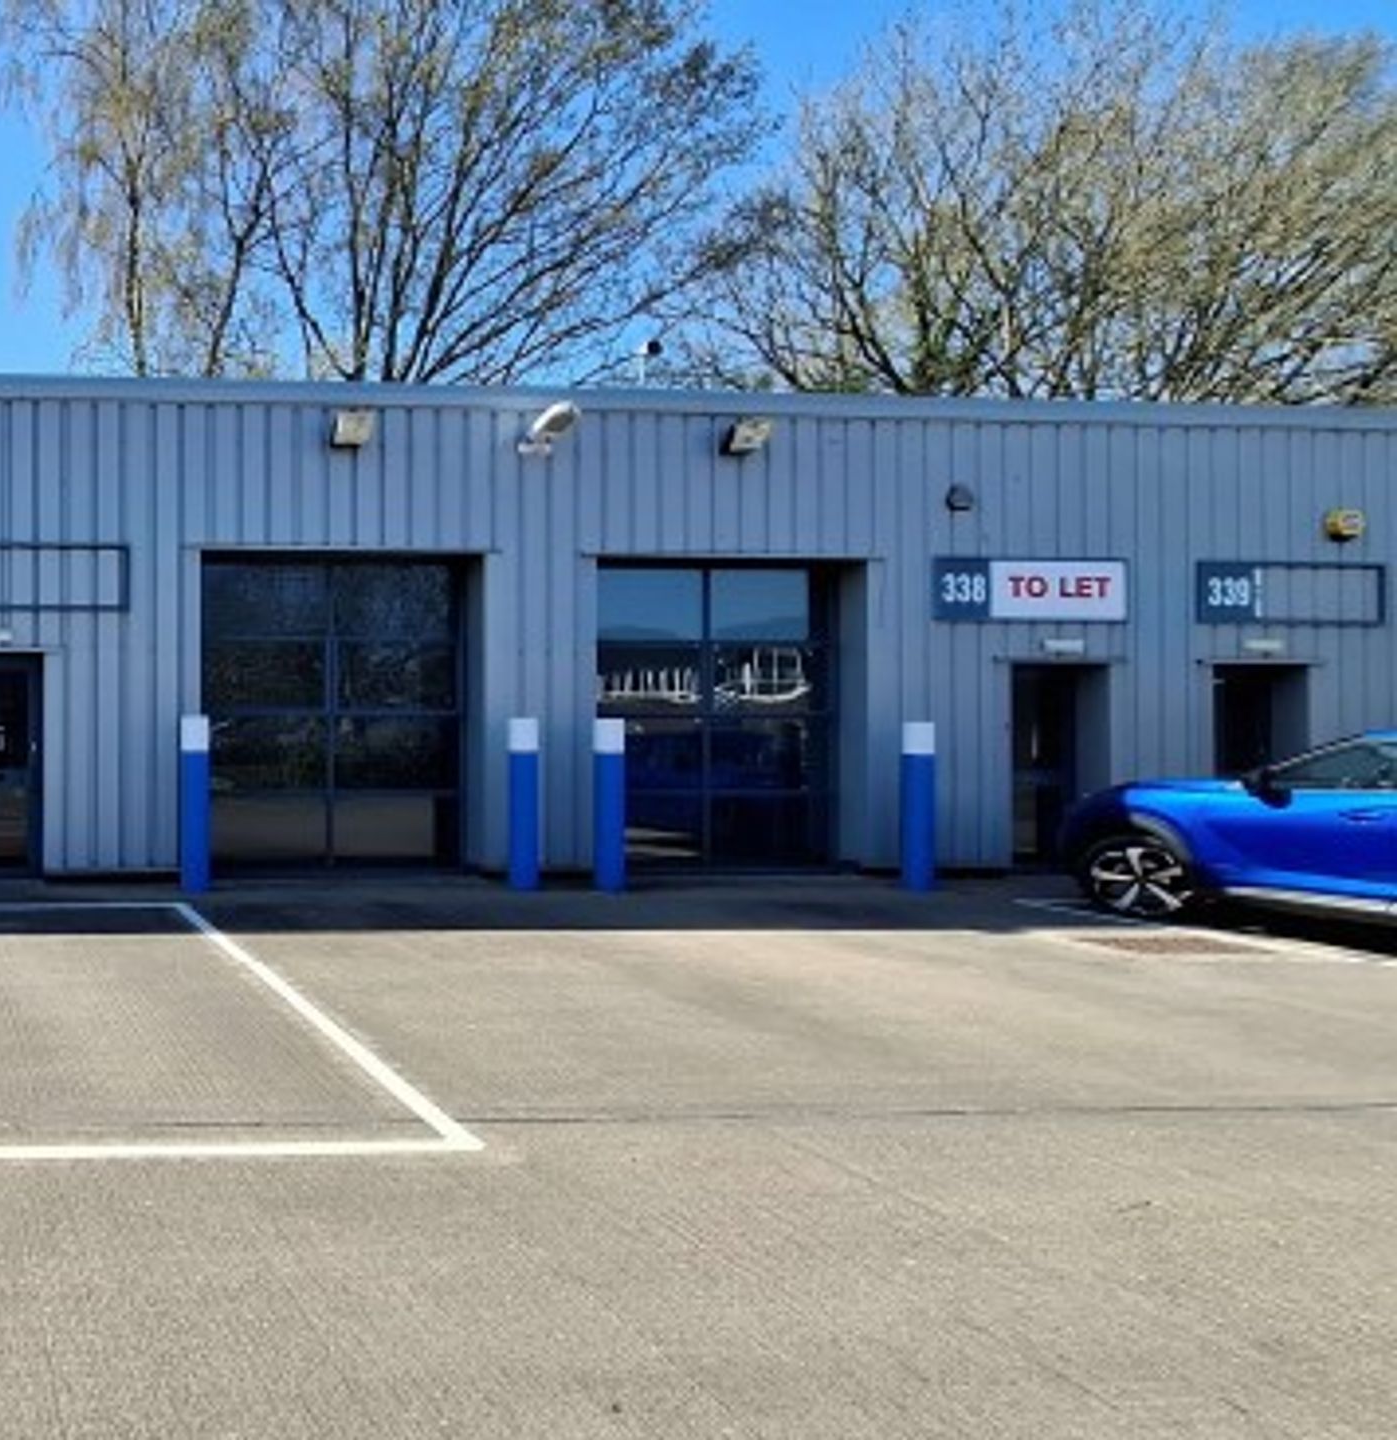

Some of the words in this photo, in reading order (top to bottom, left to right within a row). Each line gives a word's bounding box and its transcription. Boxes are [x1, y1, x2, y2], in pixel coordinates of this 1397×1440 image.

[941, 572, 986, 603] 338
[1008, 576, 1048, 598] TO
[1059, 576, 1111, 598] LET
[1208, 577, 1250, 606] 339
